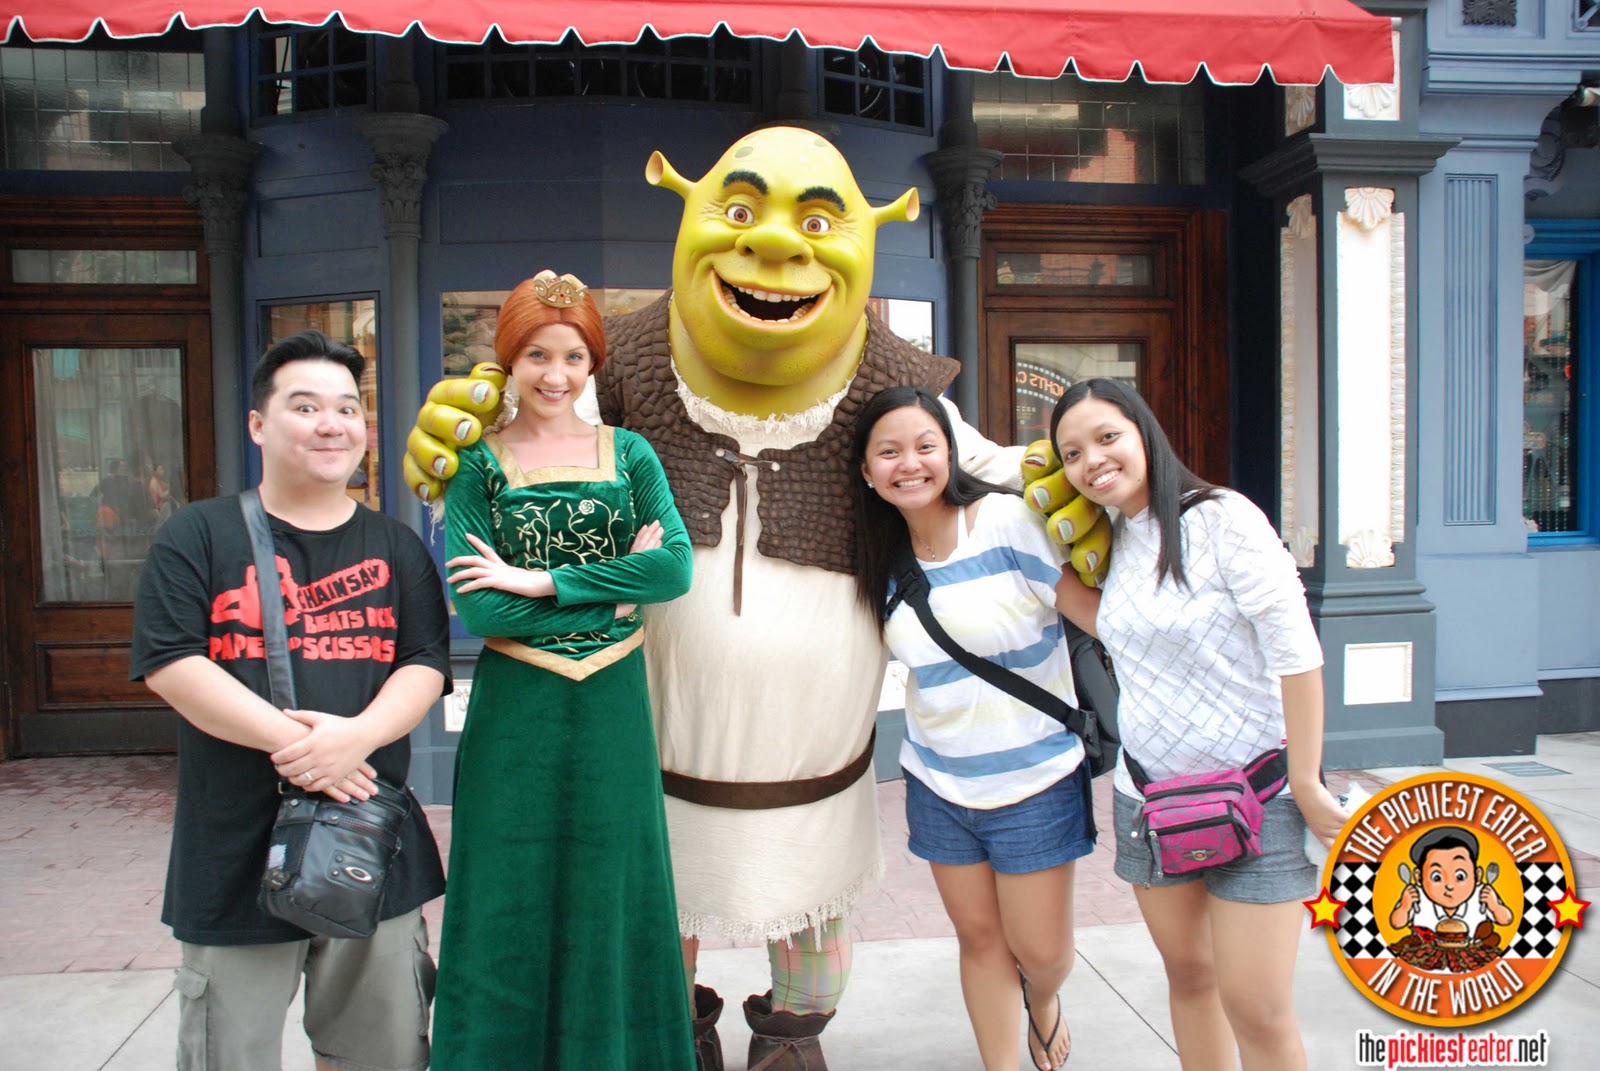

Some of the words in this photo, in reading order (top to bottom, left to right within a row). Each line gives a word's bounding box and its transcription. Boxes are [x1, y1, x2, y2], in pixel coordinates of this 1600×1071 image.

[298, 564, 381, 609] CHAINSAW
[304, 610, 364, 634] BEATS
[209, 632, 267, 661] PAPE
